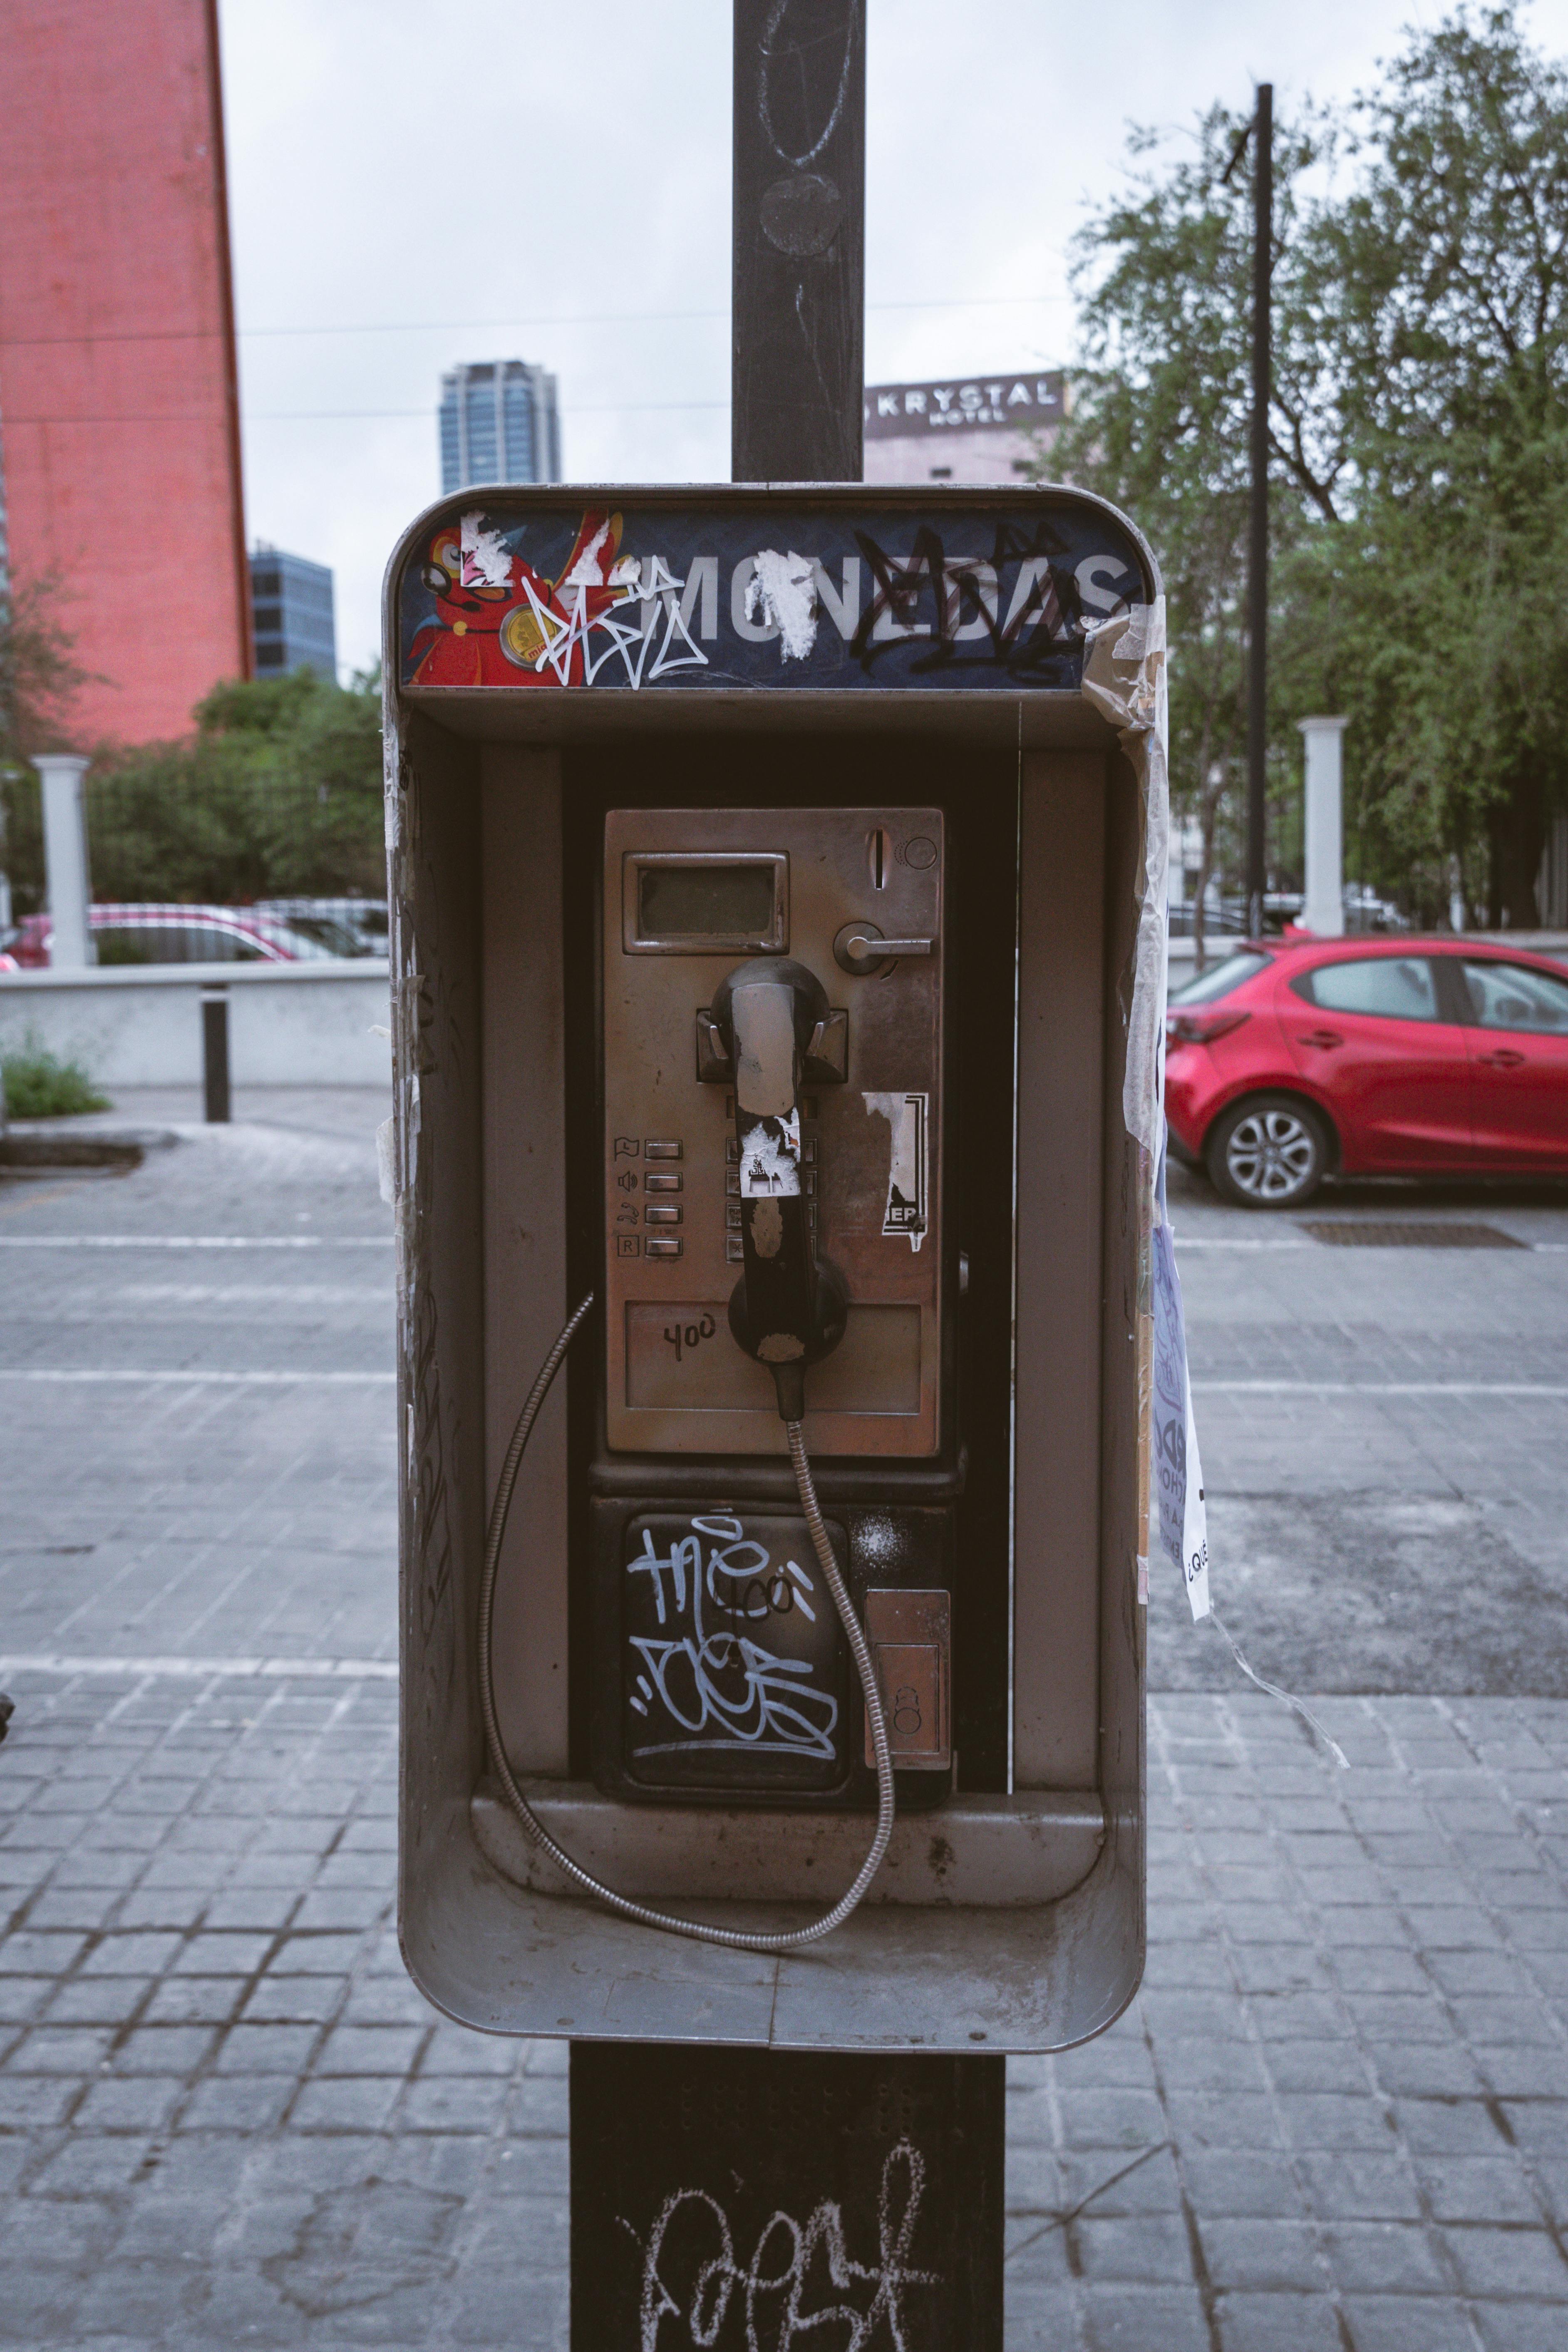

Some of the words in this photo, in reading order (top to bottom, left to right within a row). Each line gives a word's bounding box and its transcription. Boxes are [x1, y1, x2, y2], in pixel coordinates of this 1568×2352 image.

[878, 380, 1058, 417] KRYSTAL
[625, 1240, 632, 1252] R
[664, 1313, 716, 1362] 400
[1188, 1539, 1208, 1582] ¿QUÉ
